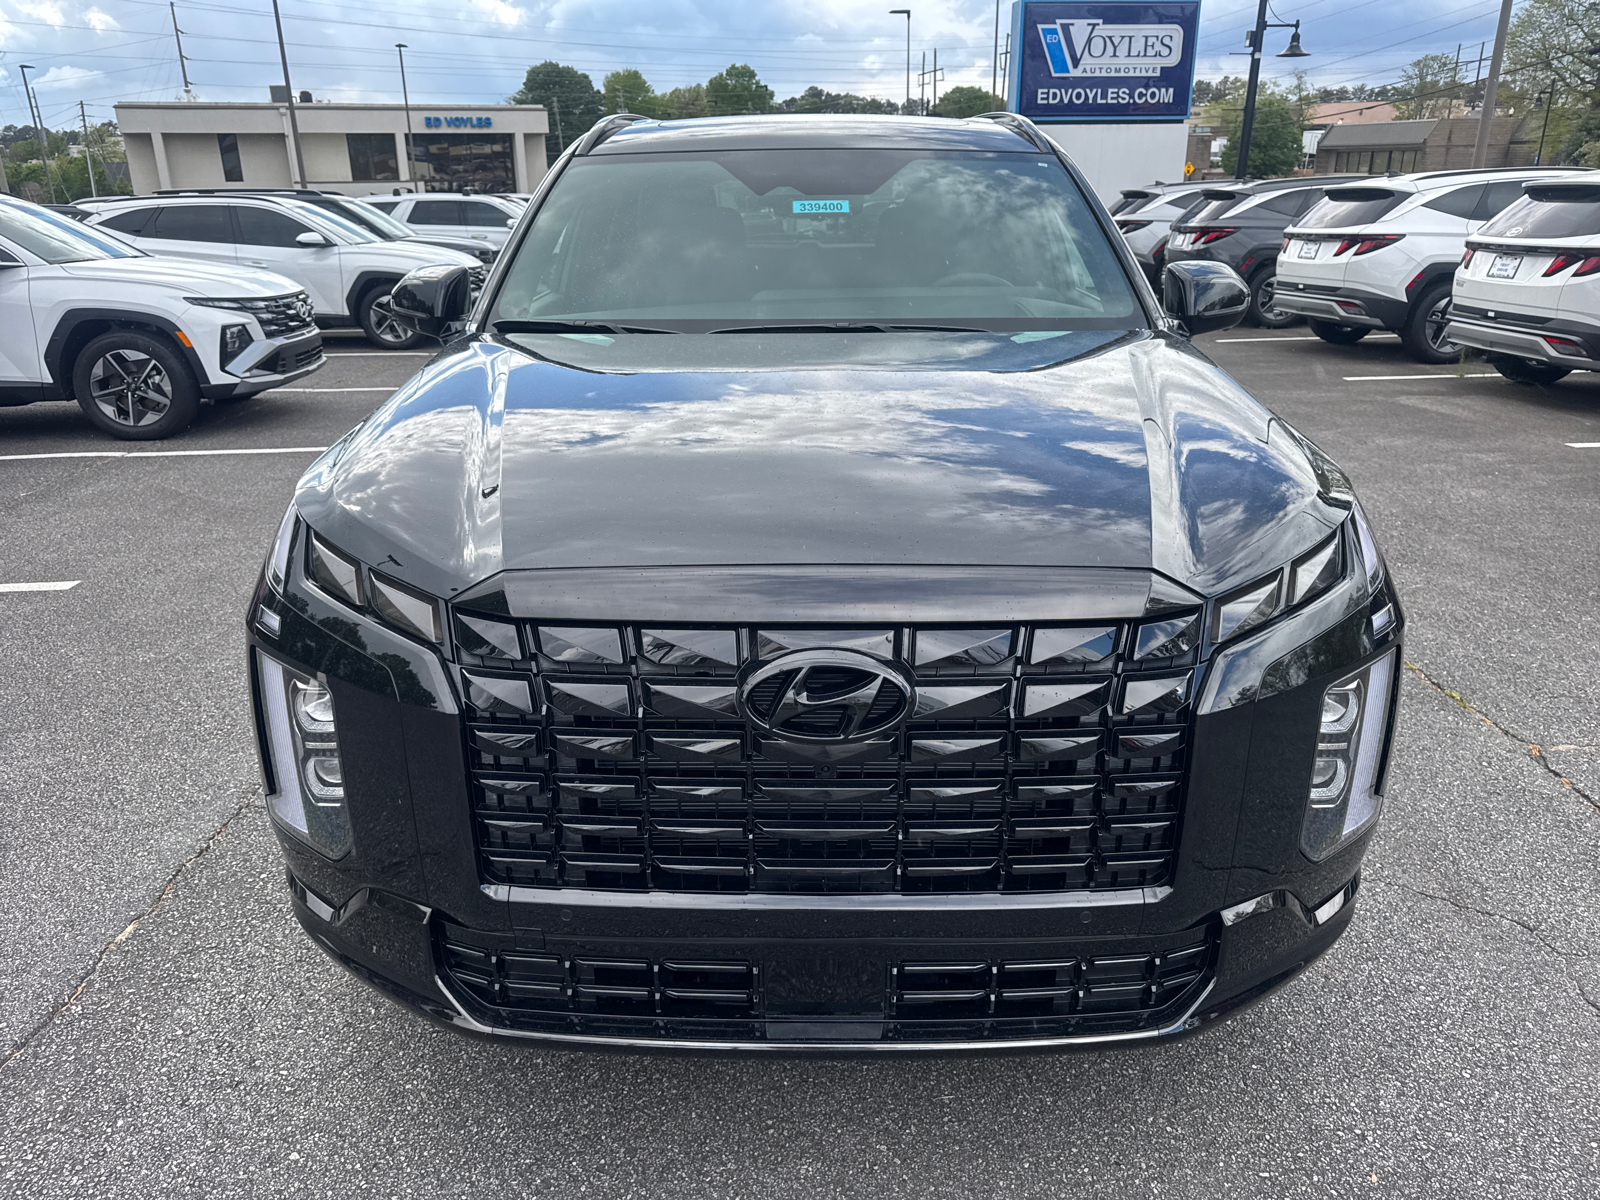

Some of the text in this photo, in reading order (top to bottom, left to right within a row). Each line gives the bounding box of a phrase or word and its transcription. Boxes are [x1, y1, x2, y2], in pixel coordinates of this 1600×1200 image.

[1046, 22, 1174, 69] ED VOYLES
[1037, 88, 1174, 104] EDVOYLES.COM
[425, 117, 492, 127] ED VOYLES
[799, 202, 843, 211] 339400
